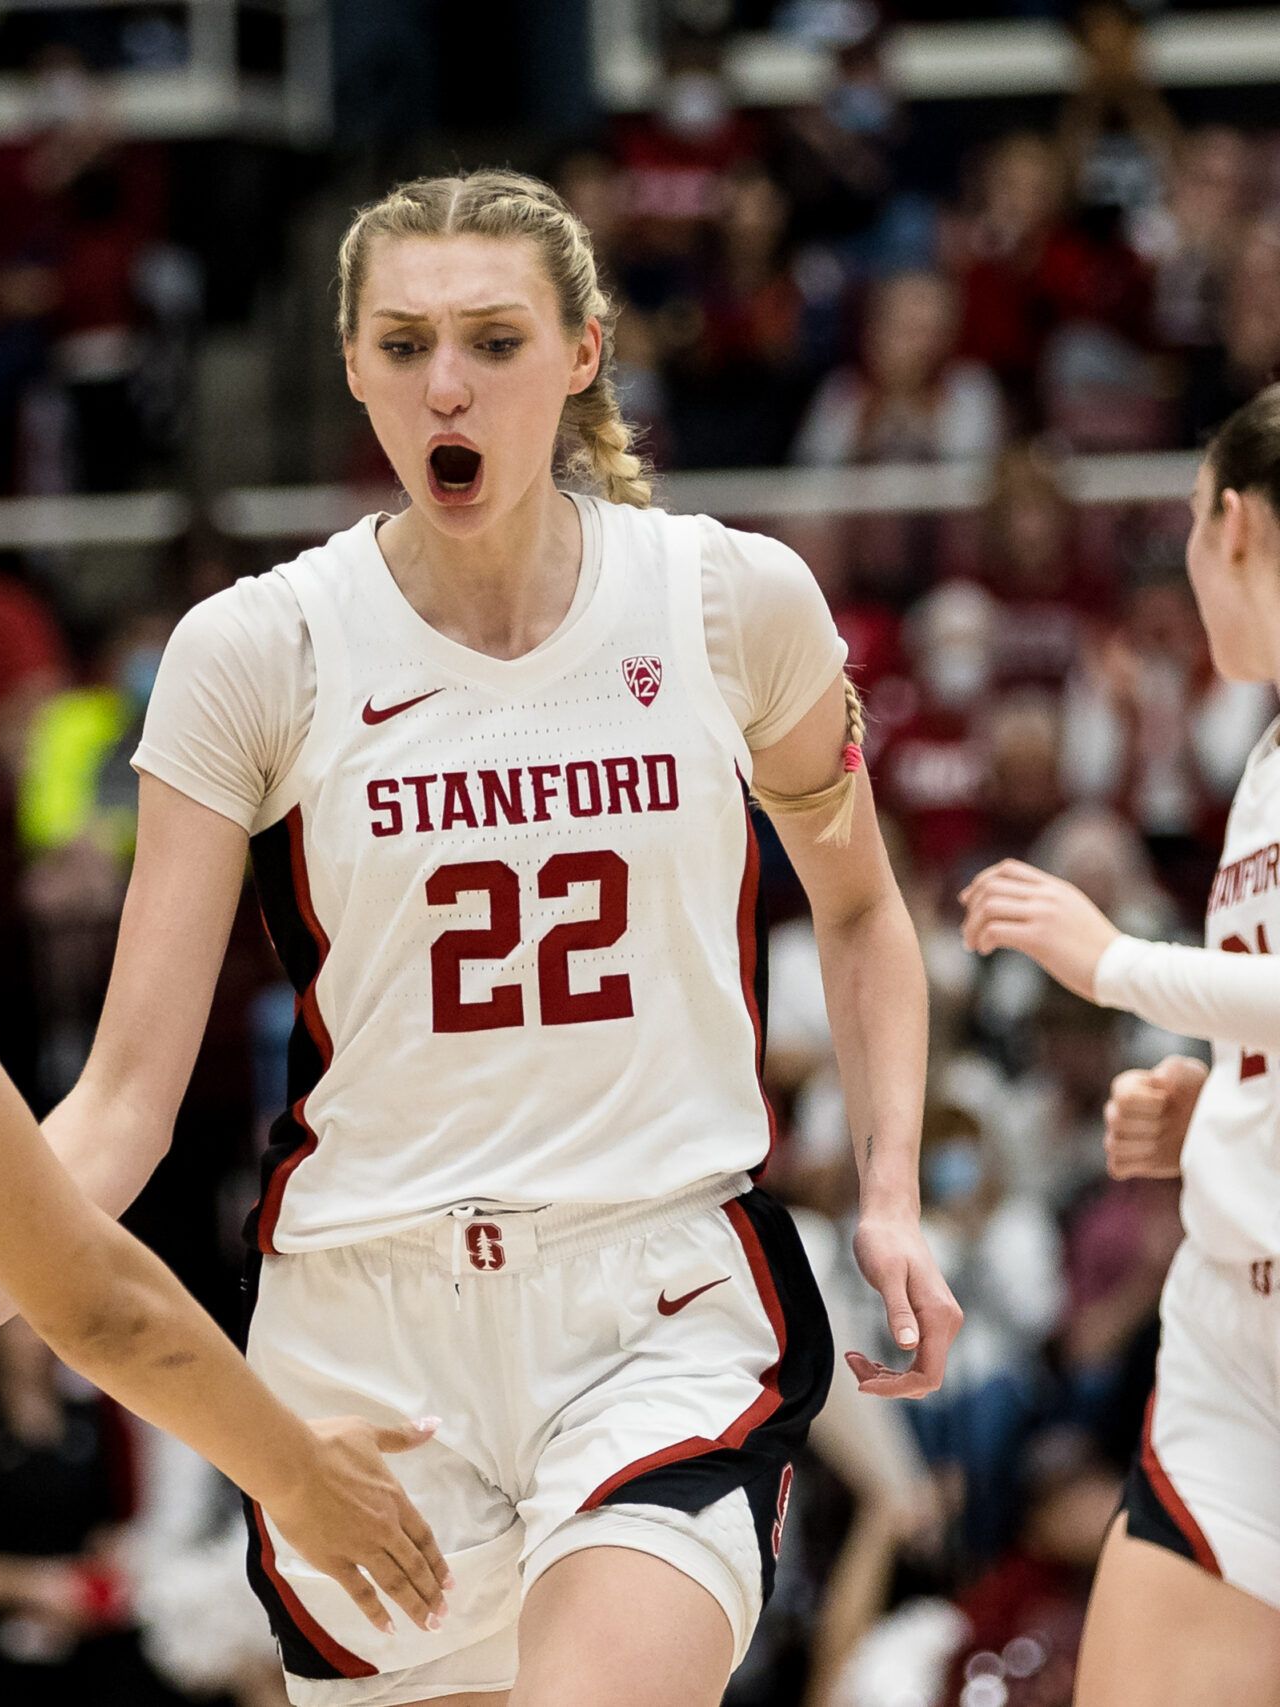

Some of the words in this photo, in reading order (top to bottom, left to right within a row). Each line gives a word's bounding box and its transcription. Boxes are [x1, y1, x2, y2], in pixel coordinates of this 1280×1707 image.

[623, 657, 662, 688] PAC
[633, 677, 656, 698] 12
[366, 753, 679, 838] STANFORD
[425, 849, 634, 1034] 22
[465, 1223, 507, 1272] S
